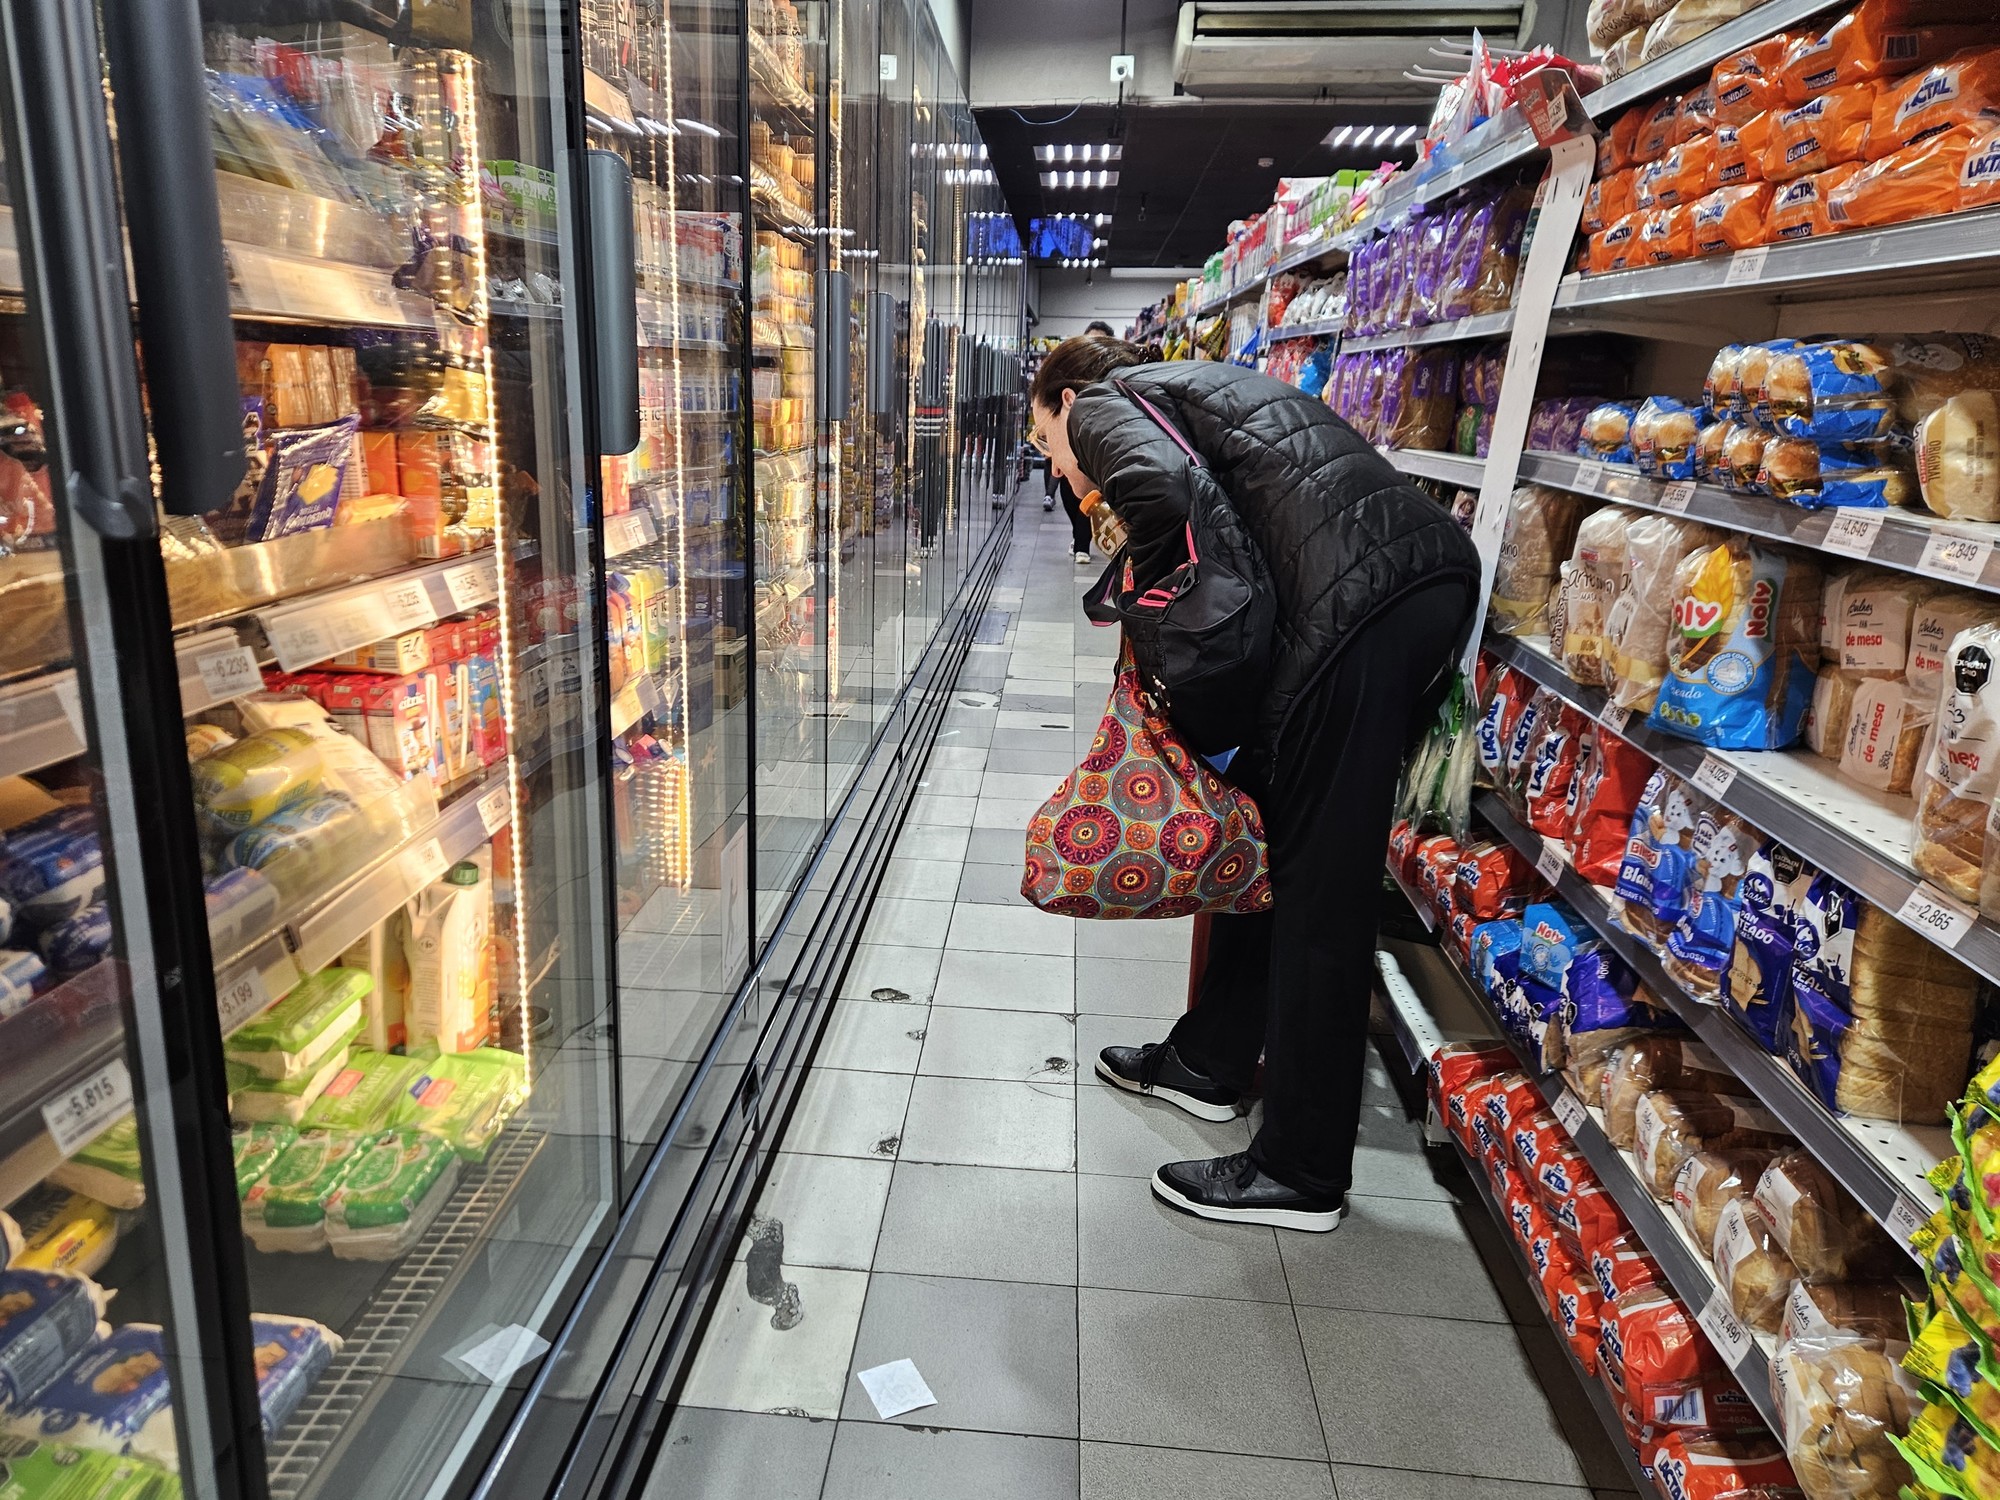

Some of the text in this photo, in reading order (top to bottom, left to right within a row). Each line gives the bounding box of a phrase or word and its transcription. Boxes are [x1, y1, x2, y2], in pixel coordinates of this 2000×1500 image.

[1904, 77, 1953, 113] LACTAL
[1928, 439, 1942, 482] ORIGINAL
[1672, 598, 1719, 628] oly
[1745, 580, 1773, 637] Noly
[1845, 631, 1883, 647] de mesa
[1915, 653, 1926, 668] de
[1481, 698, 1501, 762] LACTAL
[1862, 702, 1886, 763] de mesa
[1537, 921, 1566, 944] Noly
